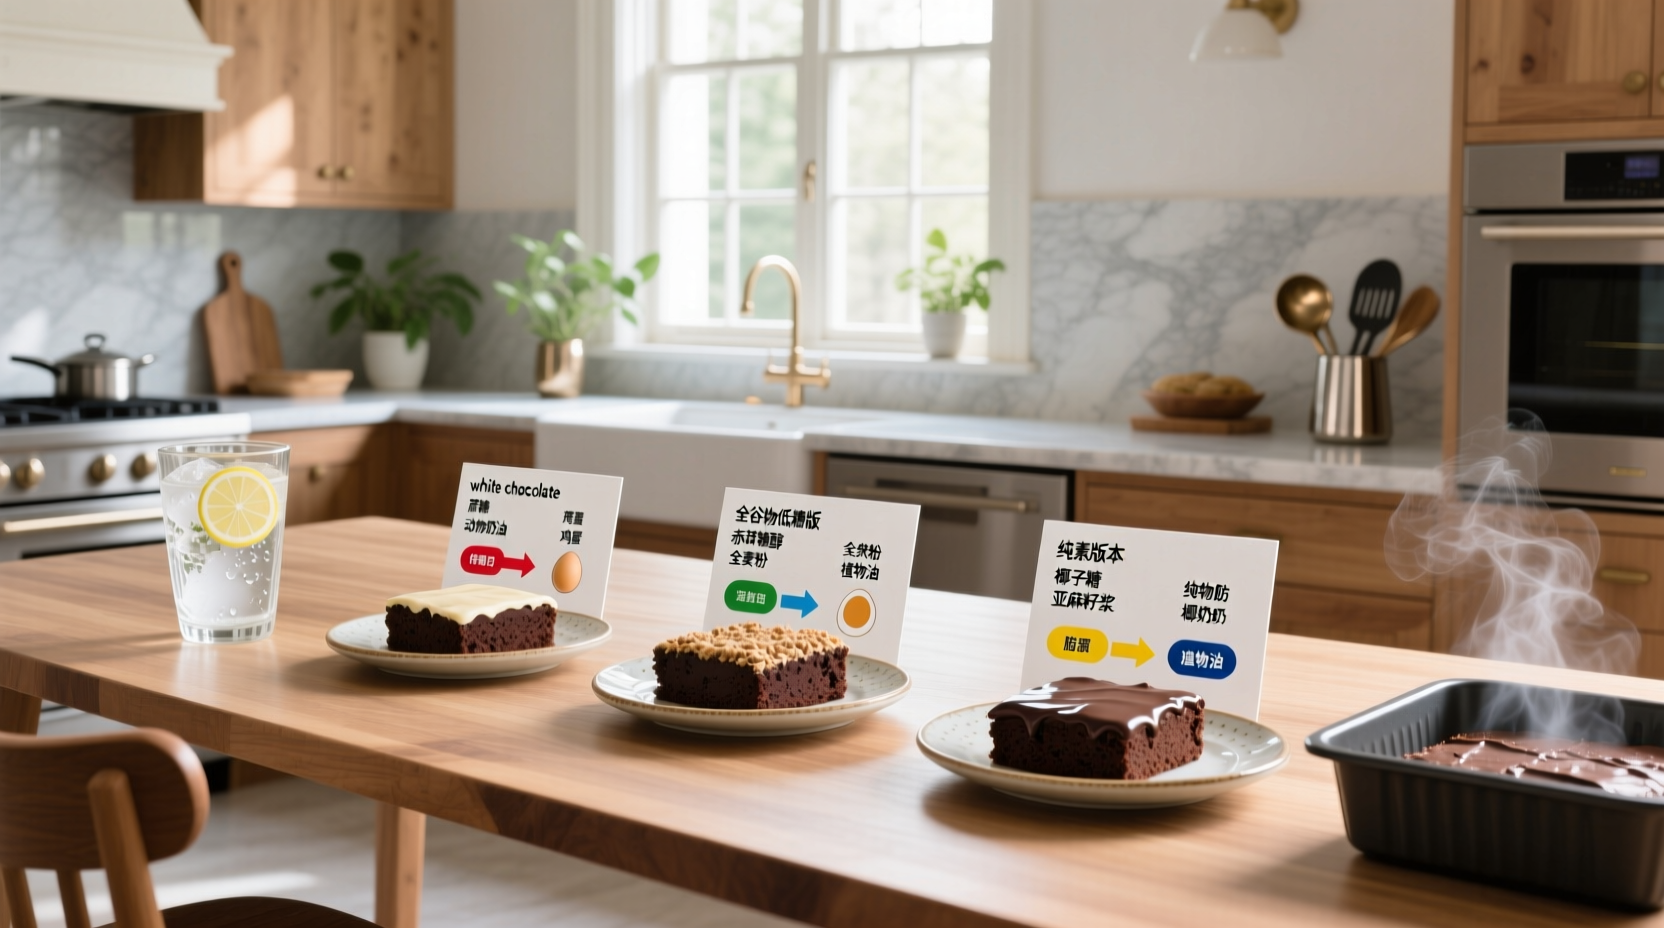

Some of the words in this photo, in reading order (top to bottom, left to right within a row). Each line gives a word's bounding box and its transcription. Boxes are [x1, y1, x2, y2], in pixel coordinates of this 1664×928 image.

[470, 477, 501, 494] white
[504, 481, 561, 499] chocolate
[1056, 540, 1125, 564] 纯素版本
[841, 562, 880, 580] 植物油
[1054, 567, 1102, 588] 椰子糖
